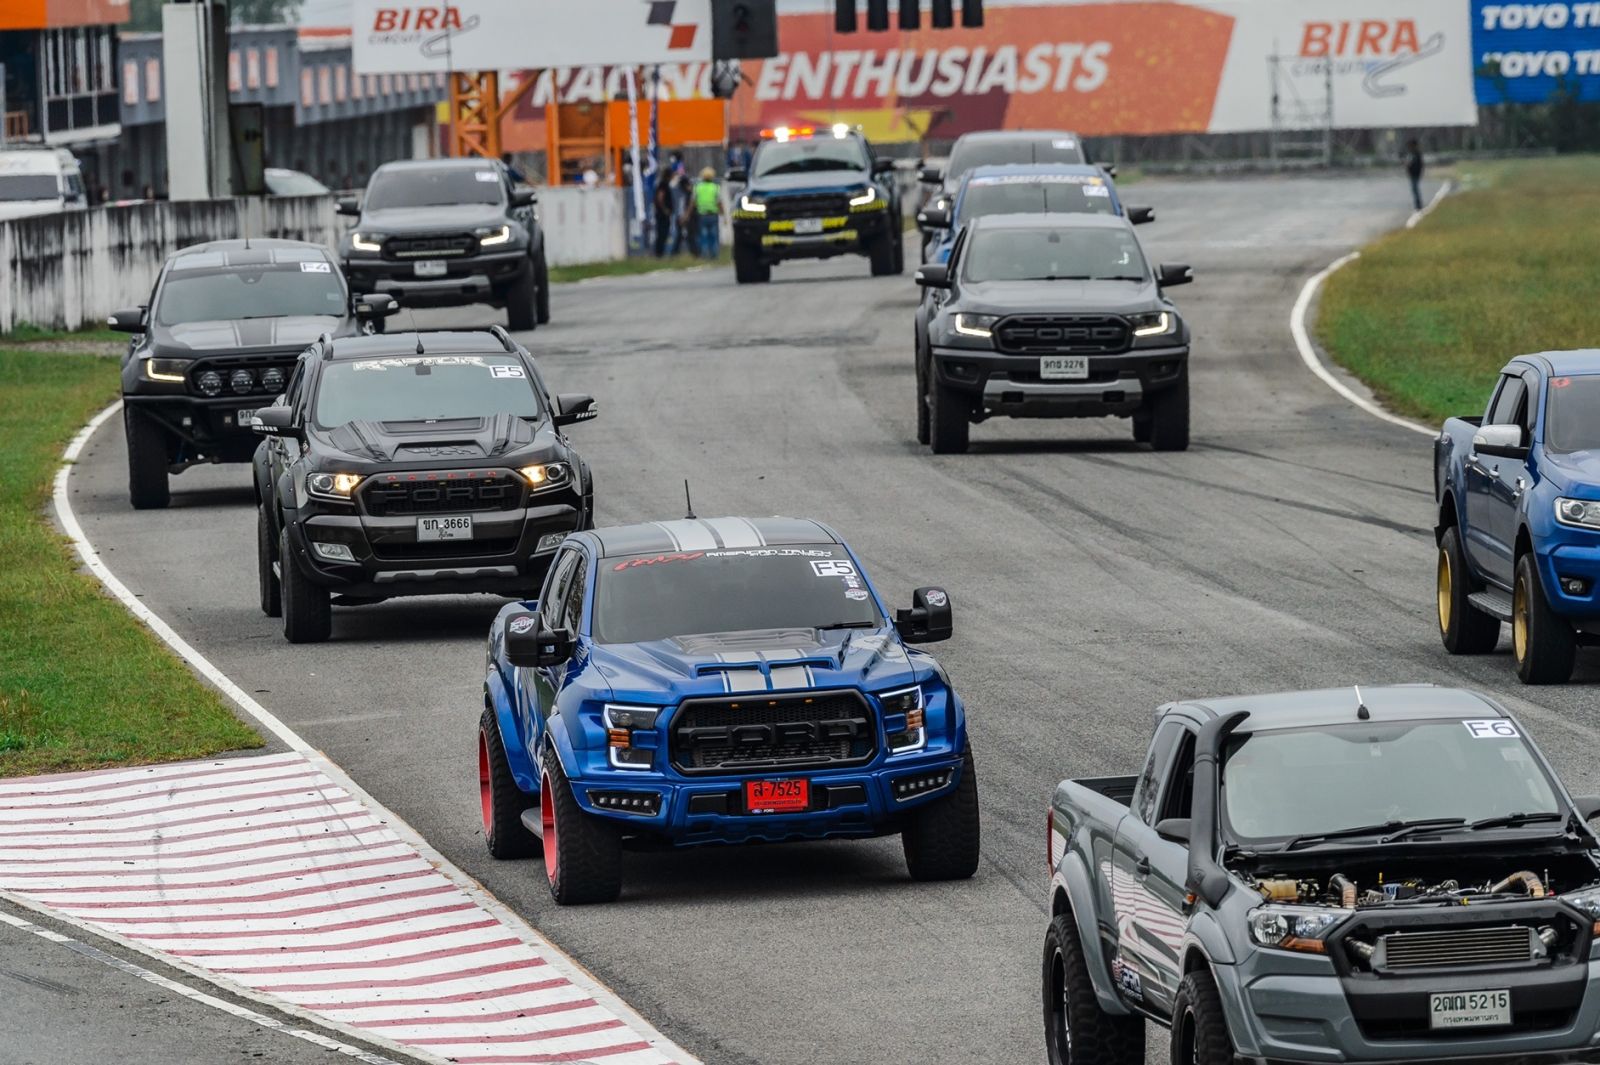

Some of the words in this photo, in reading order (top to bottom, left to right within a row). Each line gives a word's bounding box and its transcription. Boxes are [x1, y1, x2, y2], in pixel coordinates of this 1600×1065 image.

[373, 6, 463, 32] BIRA
[1481, 3, 1569, 30] TOYO
[1299, 20, 1421, 57] BIRA
[754, 41, 1112, 101] ENTHUSIASTS
[302, 263, 328, 272] F4
[1004, 327, 1122, 341] FORD
[492, 366, 523, 377] F5
[369, 484, 514, 504] FORD
[444, 518, 469, 529] 3666
[814, 561, 853, 575] F5
[677, 717, 867, 747] FORD
[1467, 720, 1518, 737] F6
[1469, 992, 1507, 1010] 5215
